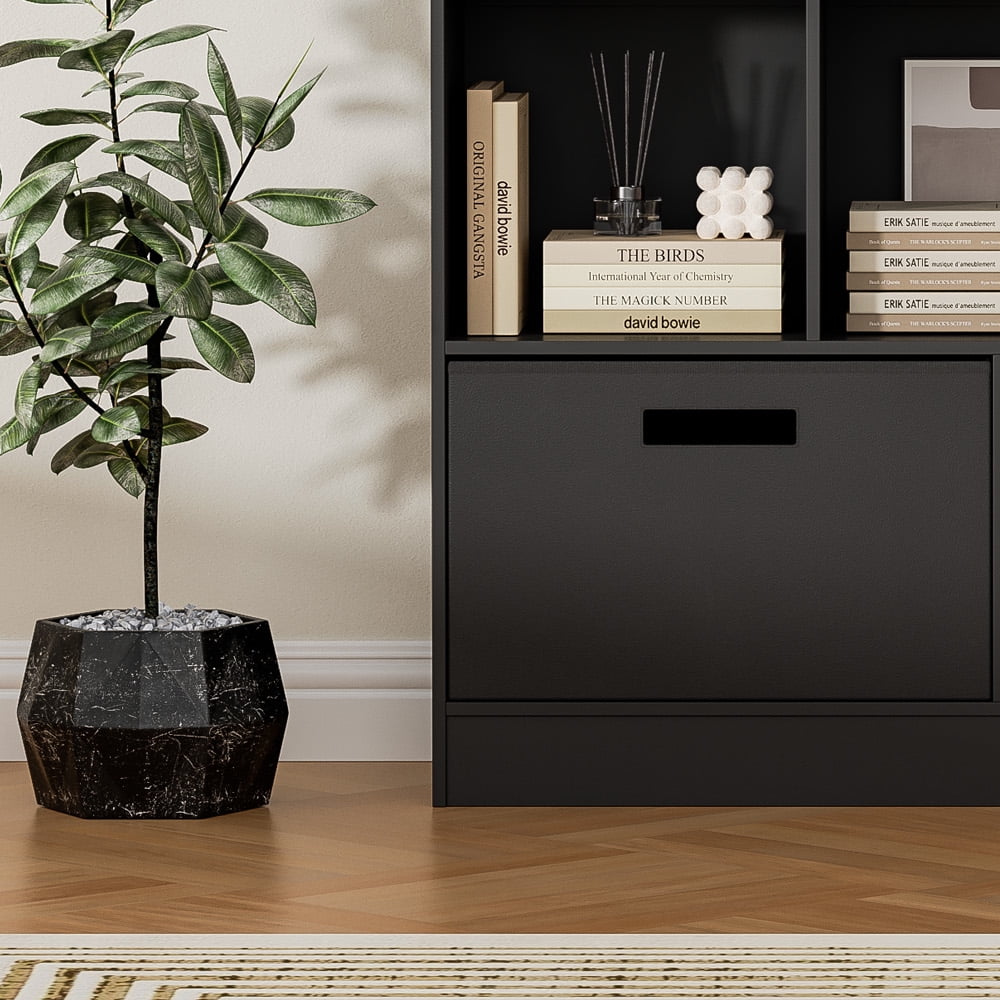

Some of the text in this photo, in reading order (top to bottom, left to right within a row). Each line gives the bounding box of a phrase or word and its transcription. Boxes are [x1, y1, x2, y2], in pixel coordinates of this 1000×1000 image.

[473, 141, 484, 279] ORIGINAL GANGSTA
[497, 181, 512, 256] david bowie
[885, 218, 903, 226] ERIK
[906, 218, 929, 226] SATIE
[617, 249, 704, 262] THE BIRDS
[885, 258, 903, 267] ERIK
[906, 258, 929, 267] SATIE
[589, 271, 733, 283] International Year of Chemistry
[594, 296, 727, 305] THE MAGICK NUMBER
[885, 300, 903, 308] ERIK
[906, 300, 929, 308] SATIE
[624, 316, 700, 329] david bowie
